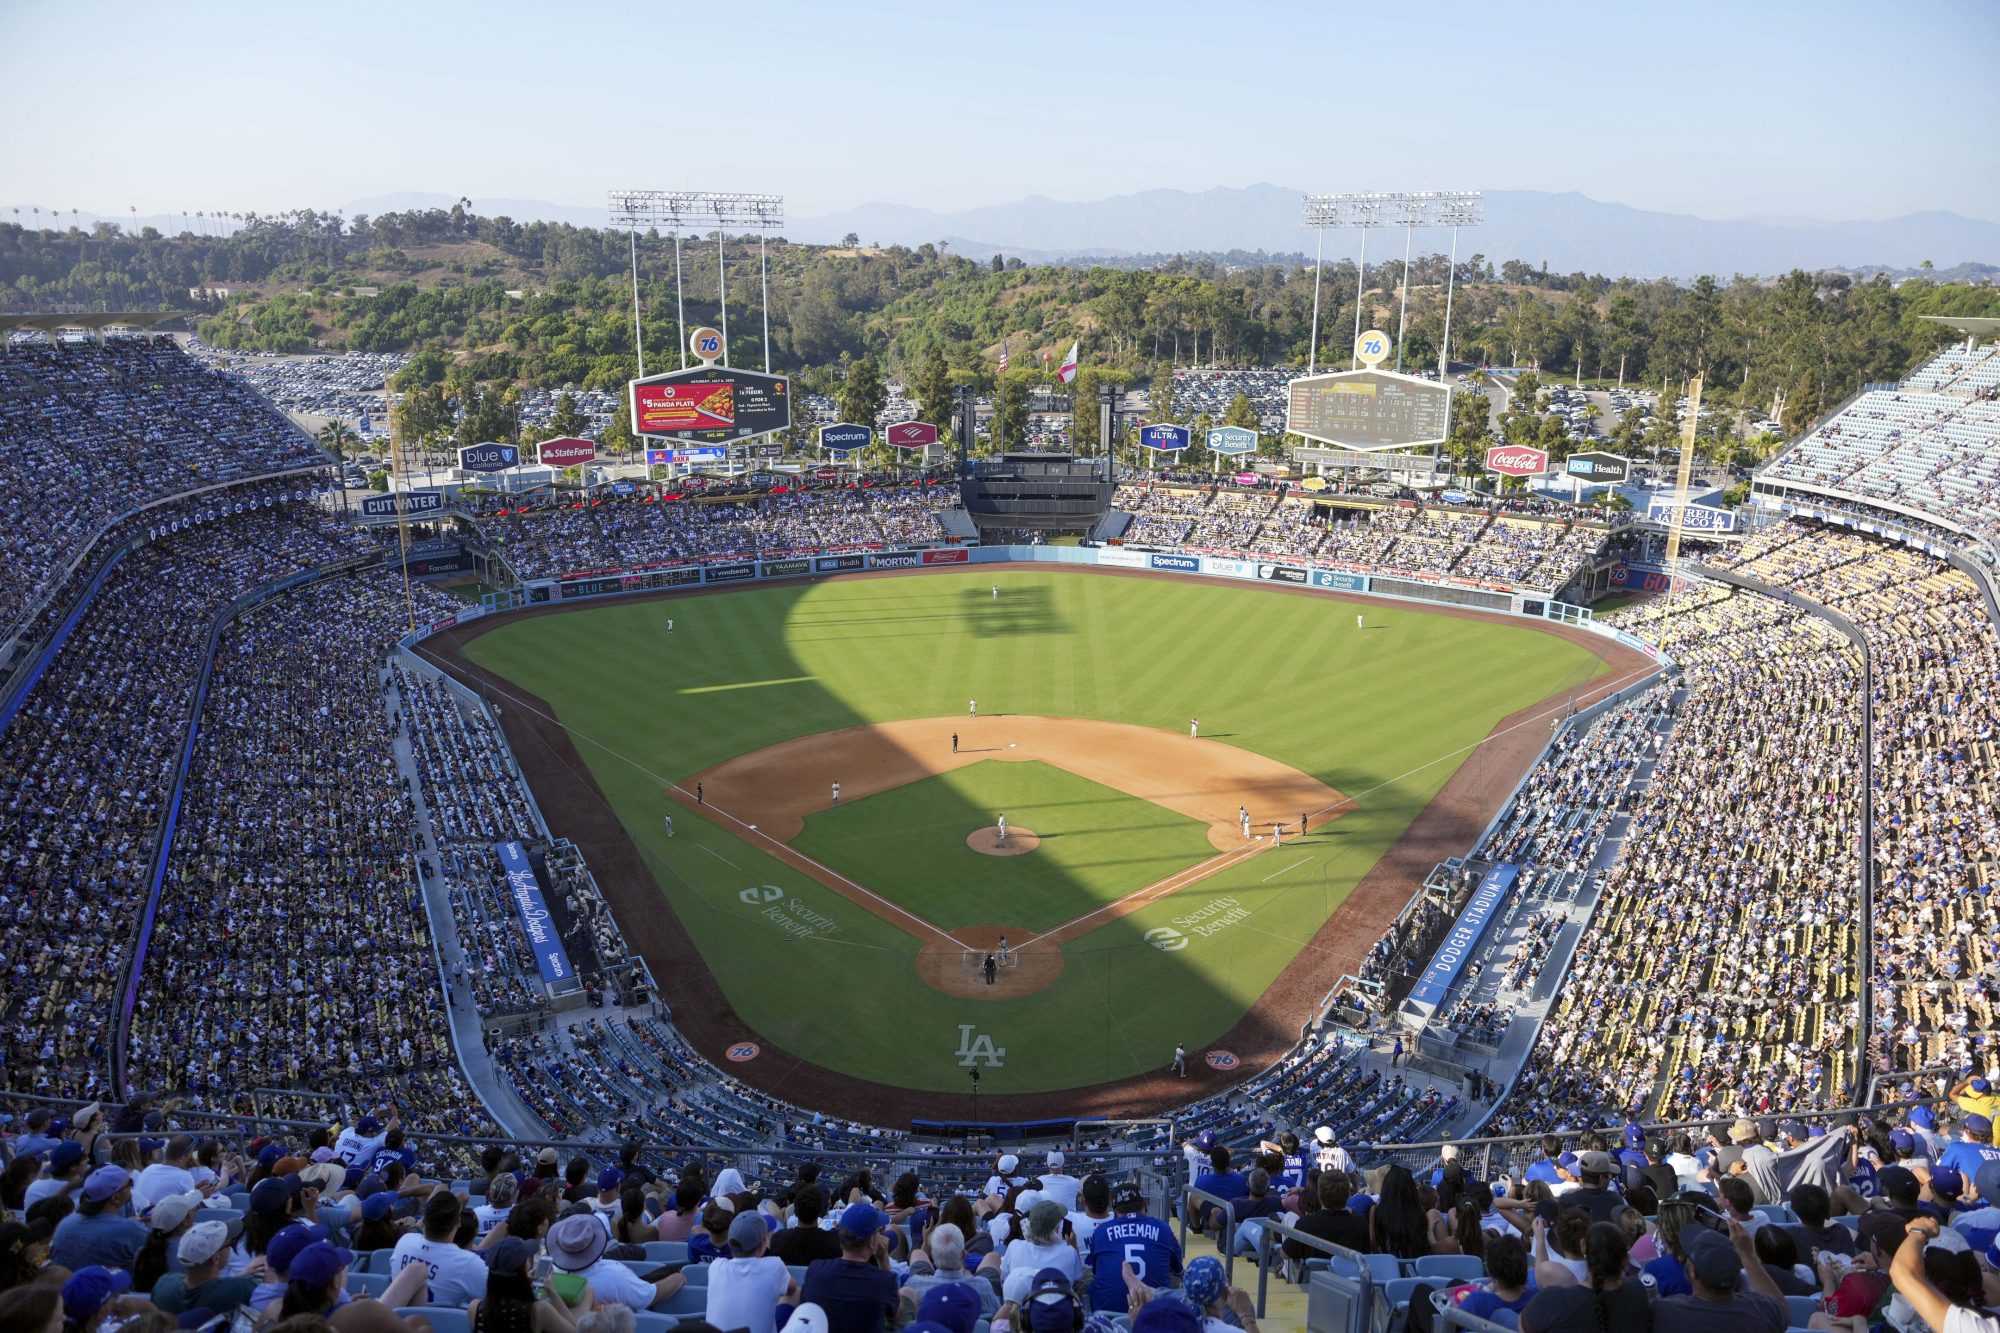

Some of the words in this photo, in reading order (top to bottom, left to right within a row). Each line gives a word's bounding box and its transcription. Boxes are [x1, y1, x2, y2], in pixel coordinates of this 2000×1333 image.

[700, 336, 719, 352] 76
[1363, 340, 1382, 354] 76
[825, 432, 864, 443] Spectrum
[1225, 434, 1252, 442] Security
[466, 449, 498, 464] blue
[1493, 452, 1540, 470] Coca-Cola
[1594, 464, 1622, 474] Health
[368, 496, 436, 513] CUTWATER
[1655, 514, 1709, 527] JALSCO
[429, 564, 458, 572] Fanatics
[839, 559, 860, 567] Health
[876, 556, 916, 567] MORTON
[1153, 556, 1191, 567] Spectrum
[1213, 561, 1233, 570] blue
[718, 568, 749, 576] vividseats
[1611, 569, 1626, 580] 76
[579, 584, 603, 594] BLUE
[506, 843, 518, 860] Spectrum
[515, 881, 538, 911] Angeles
[783, 898, 842, 934] Security
[1172, 896, 1240, 927] Security
[524, 910, 548, 943] Dodgers
[761, 906, 814, 938] Benefit
[1191, 907, 1252, 937] Benefit
[1435, 928, 1474, 972] DODGER
[1465, 883, 1502, 924] STADIUM
[548, 953, 564, 976] Spectrum
[730, 1046, 756, 1057] 76
[955, 1024, 1006, 1067] LA
[1212, 1055, 1235, 1066] 76
[343, 1138, 364, 1152] OHTANI
[1106, 1224, 1159, 1241] FREEMAN
[1124, 1244, 1145, 1280] 5
